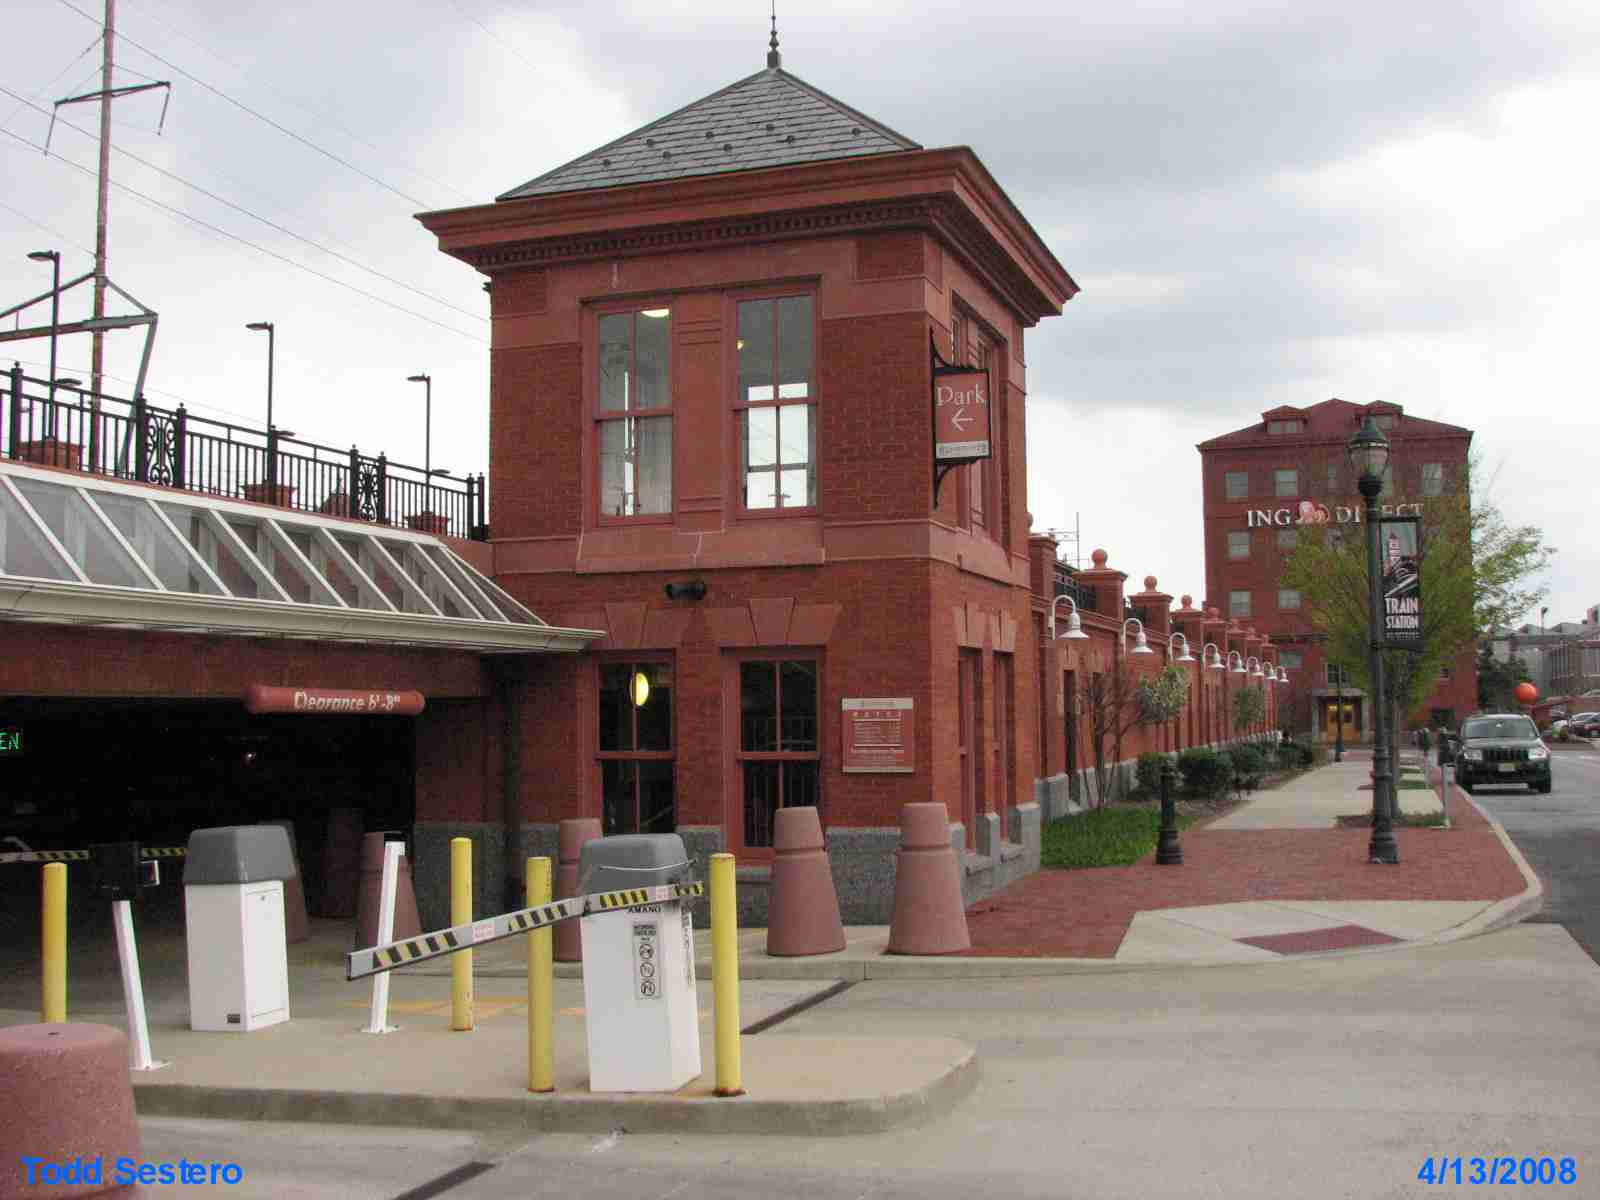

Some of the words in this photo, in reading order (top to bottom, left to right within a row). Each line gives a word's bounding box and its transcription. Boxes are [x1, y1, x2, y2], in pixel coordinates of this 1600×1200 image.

[937, 383, 985, 407] Park
[1247, 508, 1291, 527] ING
[1336, 504, 1425, 523] DIECT
[1384, 597, 1418, 613] TRAIN
[1385, 615, 1418, 629] STATION
[294, 691, 367, 712] Clearance
